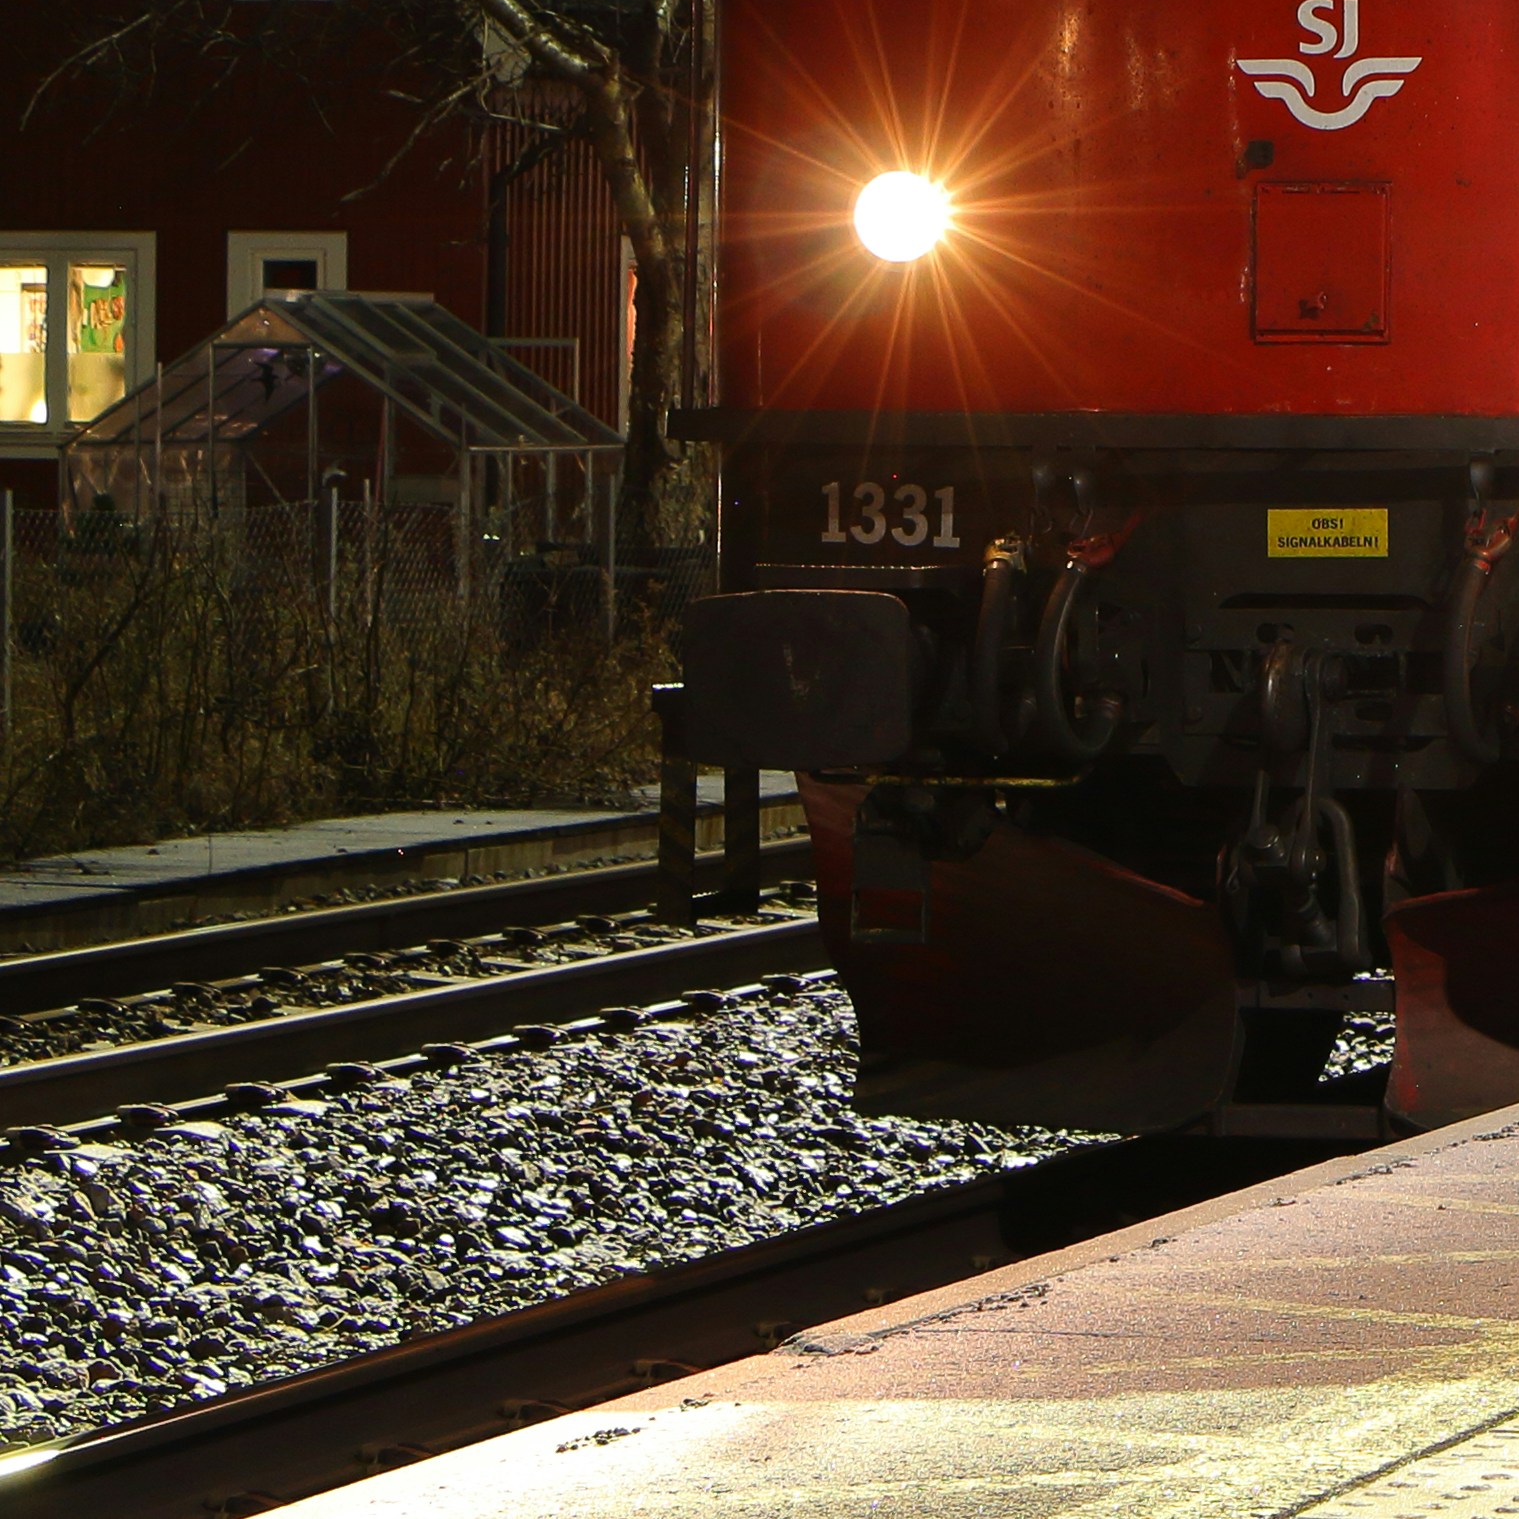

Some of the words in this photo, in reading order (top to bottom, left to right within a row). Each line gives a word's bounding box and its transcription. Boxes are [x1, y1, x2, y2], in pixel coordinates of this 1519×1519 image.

[821, 481, 961, 548] 1331
[1311, 517, 1344, 530] OBS!
[1277, 536, 1379, 549] SIGNALKABELN!
